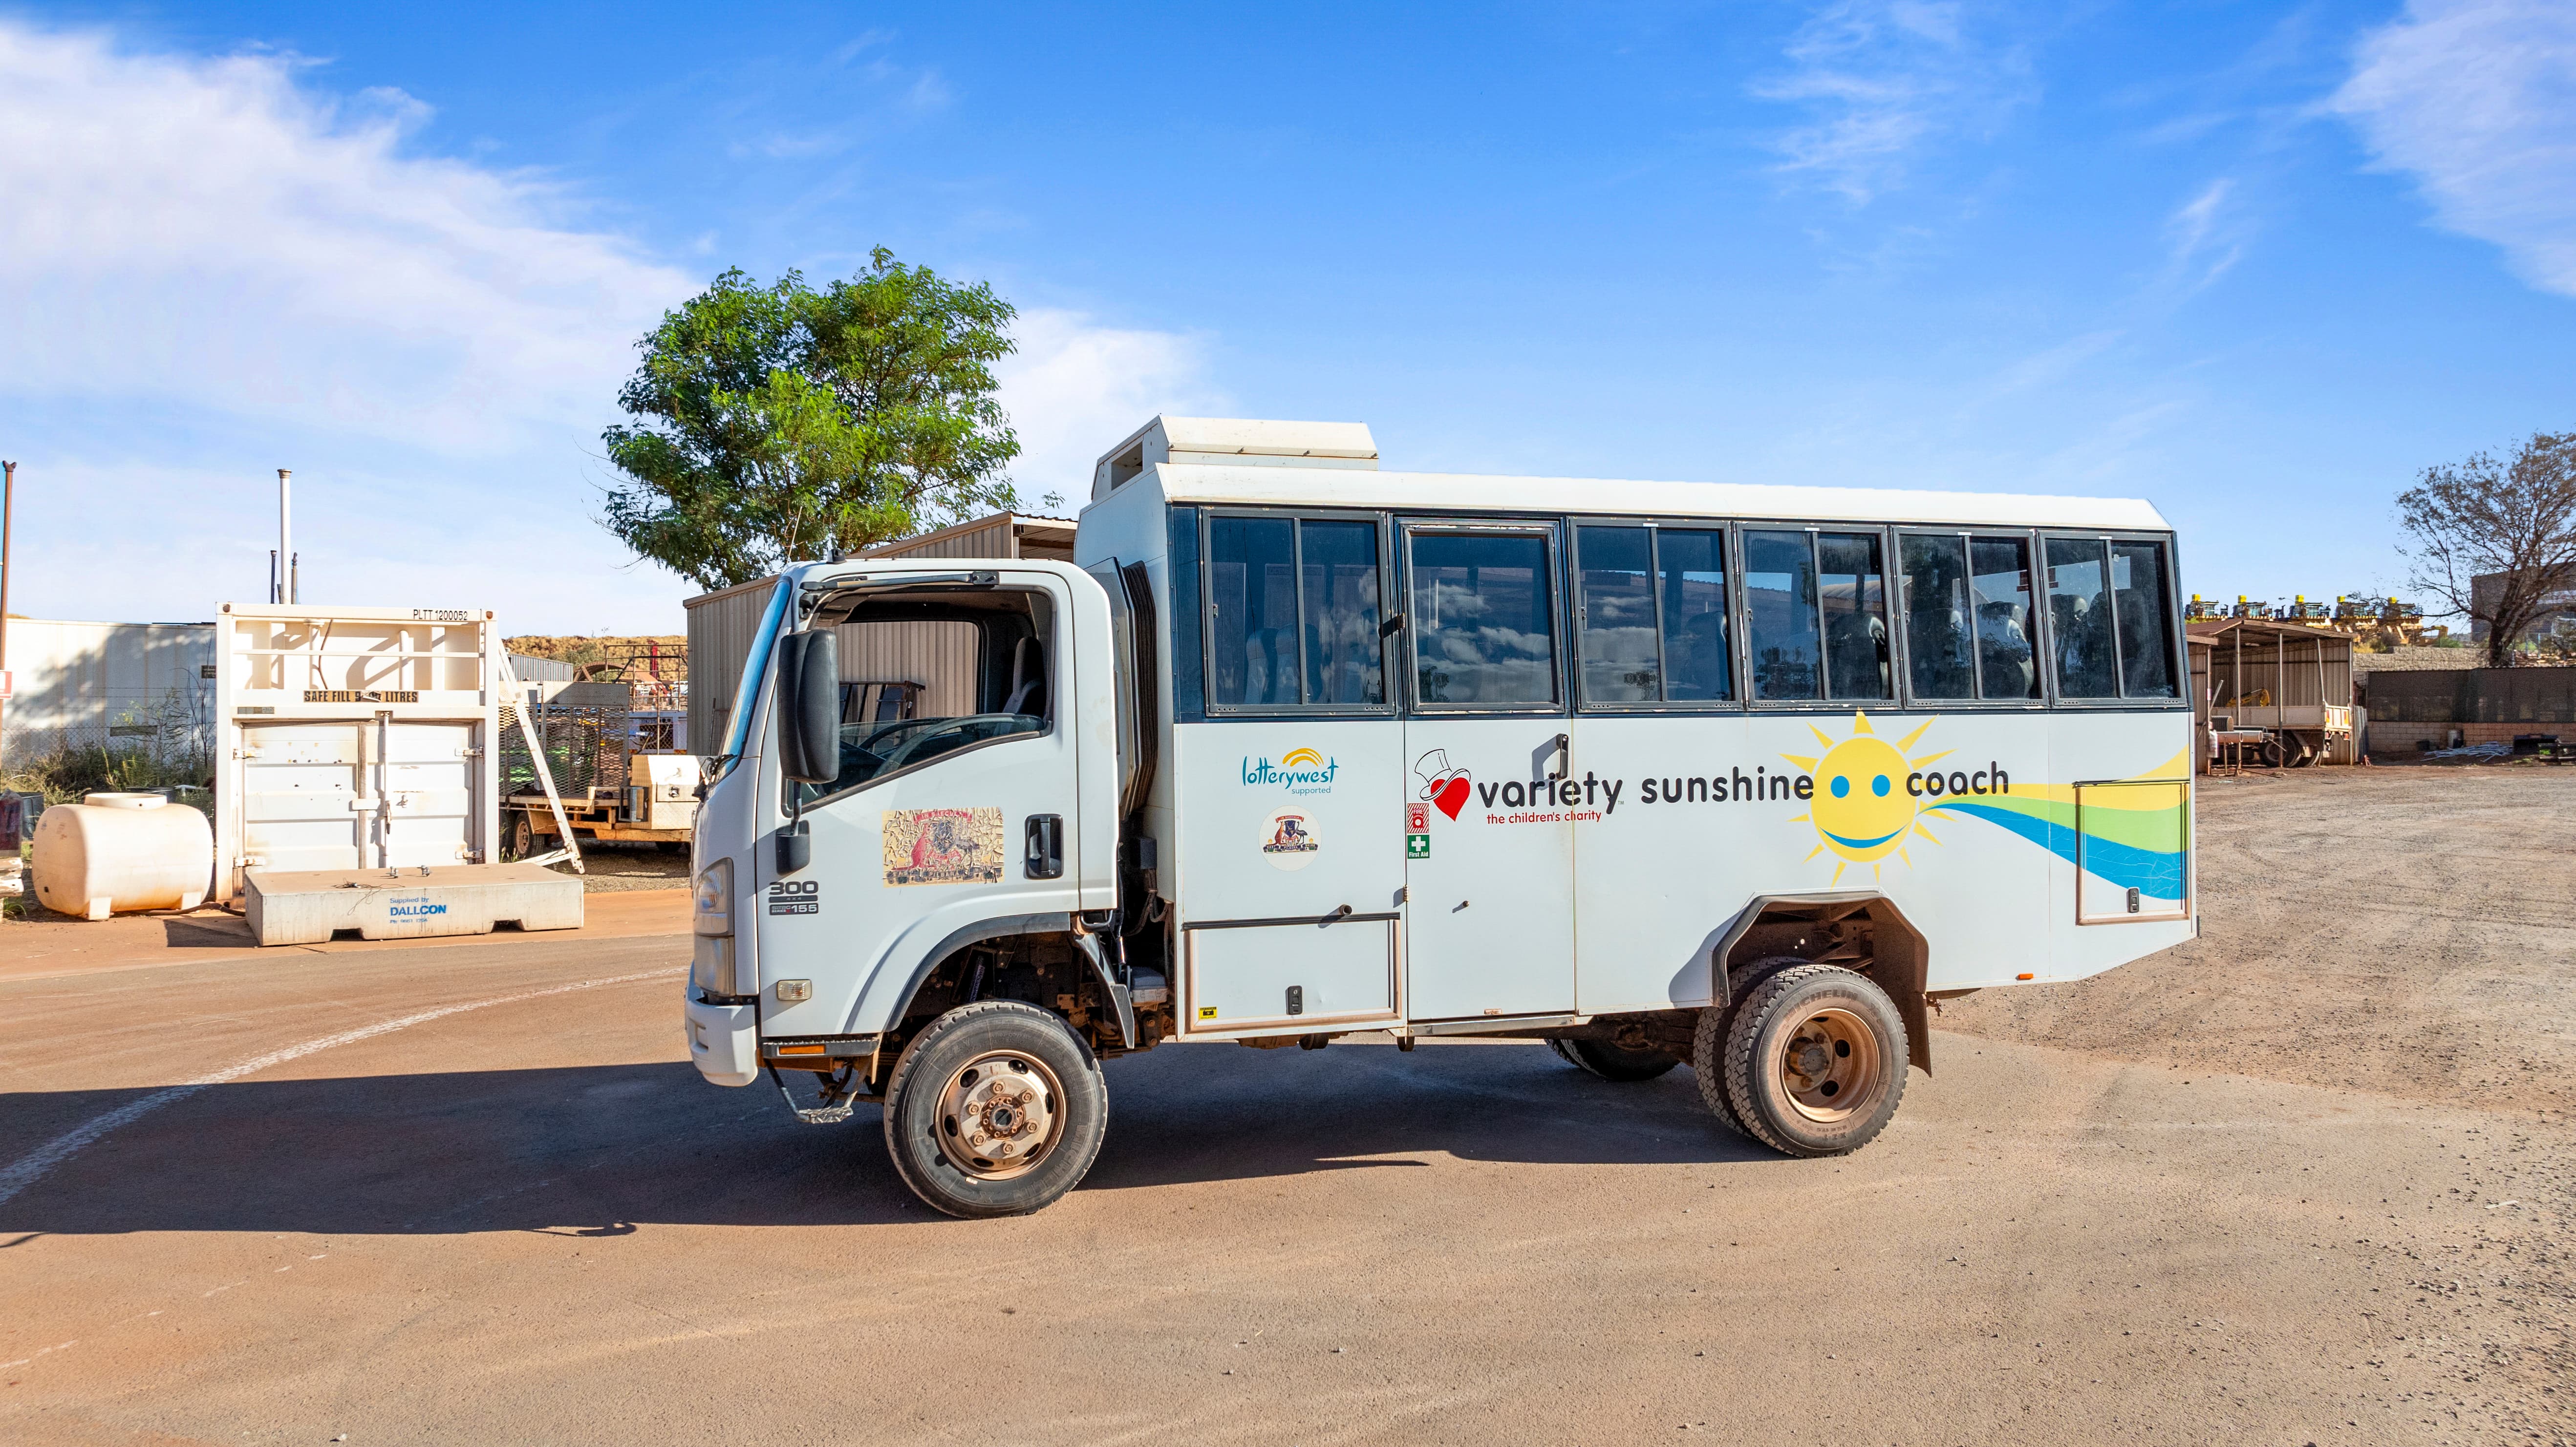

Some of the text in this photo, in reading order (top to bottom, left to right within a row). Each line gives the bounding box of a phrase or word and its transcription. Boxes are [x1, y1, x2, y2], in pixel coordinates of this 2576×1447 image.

[413, 609, 468, 620] PLTT 1200052
[304, 691, 328, 702] SAFE
[332, 691, 350, 702] FILL
[386, 691, 417, 702] LITRES
[1243, 756, 1339, 789] lotterywest
[1291, 786, 1331, 796] supported
[1478, 771, 1623, 814] variety
[1641, 766, 1814, 804] sunshine
[1906, 761, 2009, 797] coach
[1487, 810, 1602, 824] the children's charity
[769, 880, 818, 895] 300
[390, 904, 447, 916] DALLCON
[791, 904, 817, 913] 155
